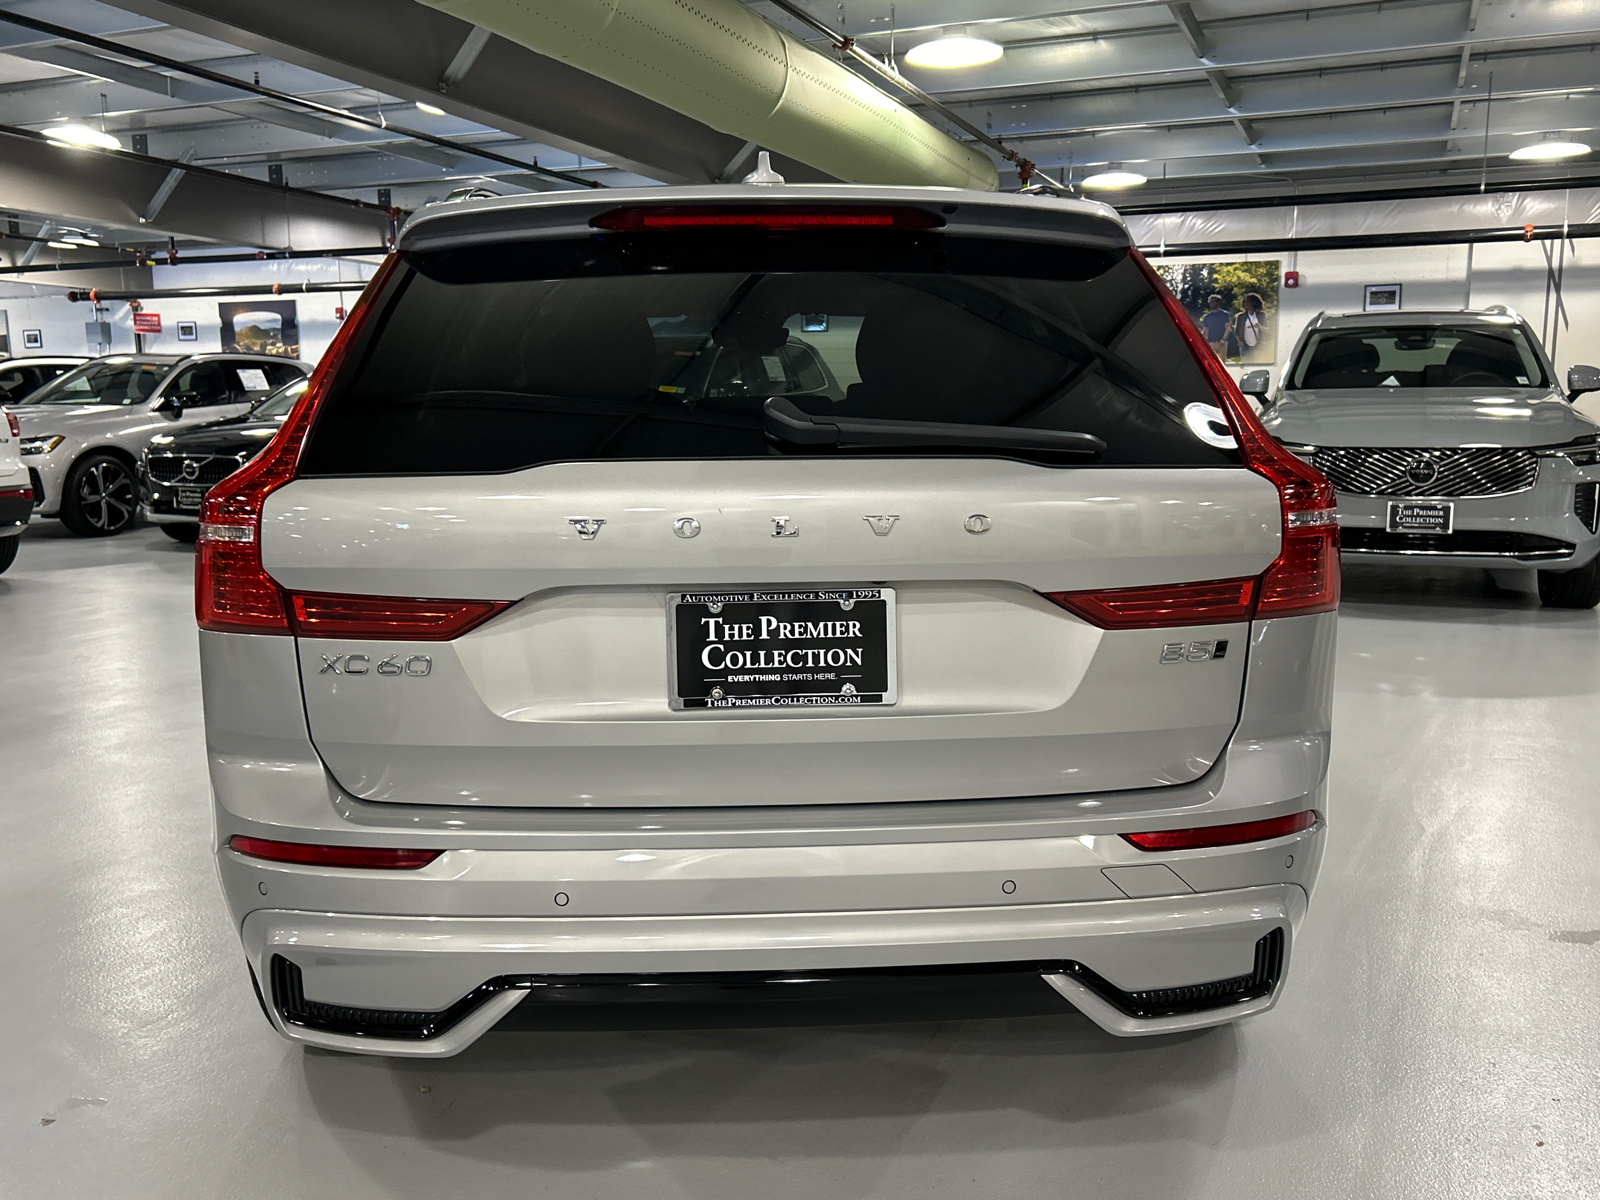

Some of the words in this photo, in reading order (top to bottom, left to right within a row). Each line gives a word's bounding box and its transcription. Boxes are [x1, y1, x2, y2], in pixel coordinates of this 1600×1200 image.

[1396, 508, 1413, 516] THE
[1413, 508, 1444, 517] PREMIER
[1396, 515, 1444, 524] COLLECTION
[568, 514, 993, 540] VOLVO
[683, 593, 750, 603] AUTOMOTIVE
[752, 591, 816, 602] EXCELLENCE
[818, 591, 848, 600] SINCE
[852, 590, 879, 599] 1995
[701, 617, 754, 641] THE
[758, 615, 863, 640] PREMIER
[701, 644, 863, 670] COLLECTION
[1159, 641, 1212, 664] B5
[727, 674, 781, 682] EVERYTHING
[782, 673, 813, 681] STARTS
[813, 672, 838, 681] HERE.
